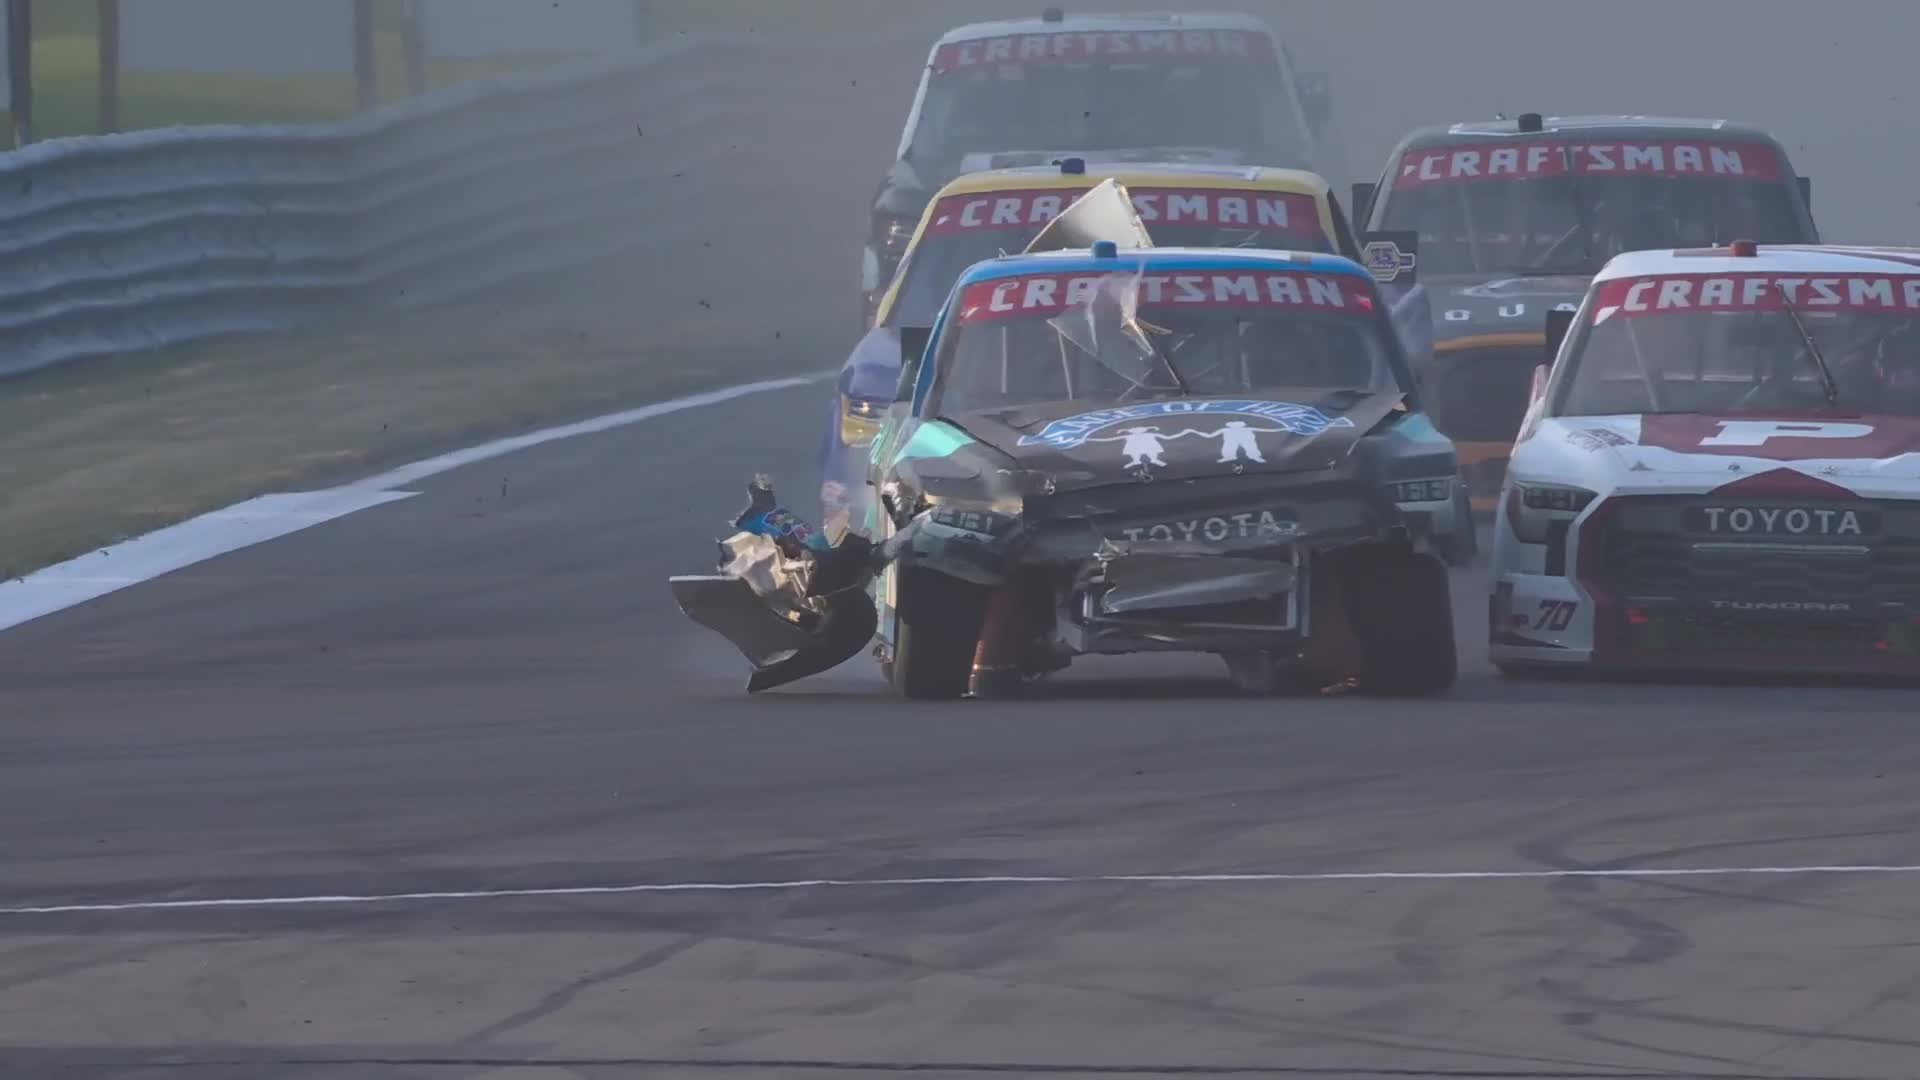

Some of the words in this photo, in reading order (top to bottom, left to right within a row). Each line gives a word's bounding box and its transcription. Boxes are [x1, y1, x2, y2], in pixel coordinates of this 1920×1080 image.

[959, 192, 1289, 228] CRASMAN
[1698, 420, 1875, 446] P
[1123, 511, 1280, 542] TOYOTA
[1704, 507, 1862, 534] TOYOTA
[1533, 599, 1579, 631] 70
